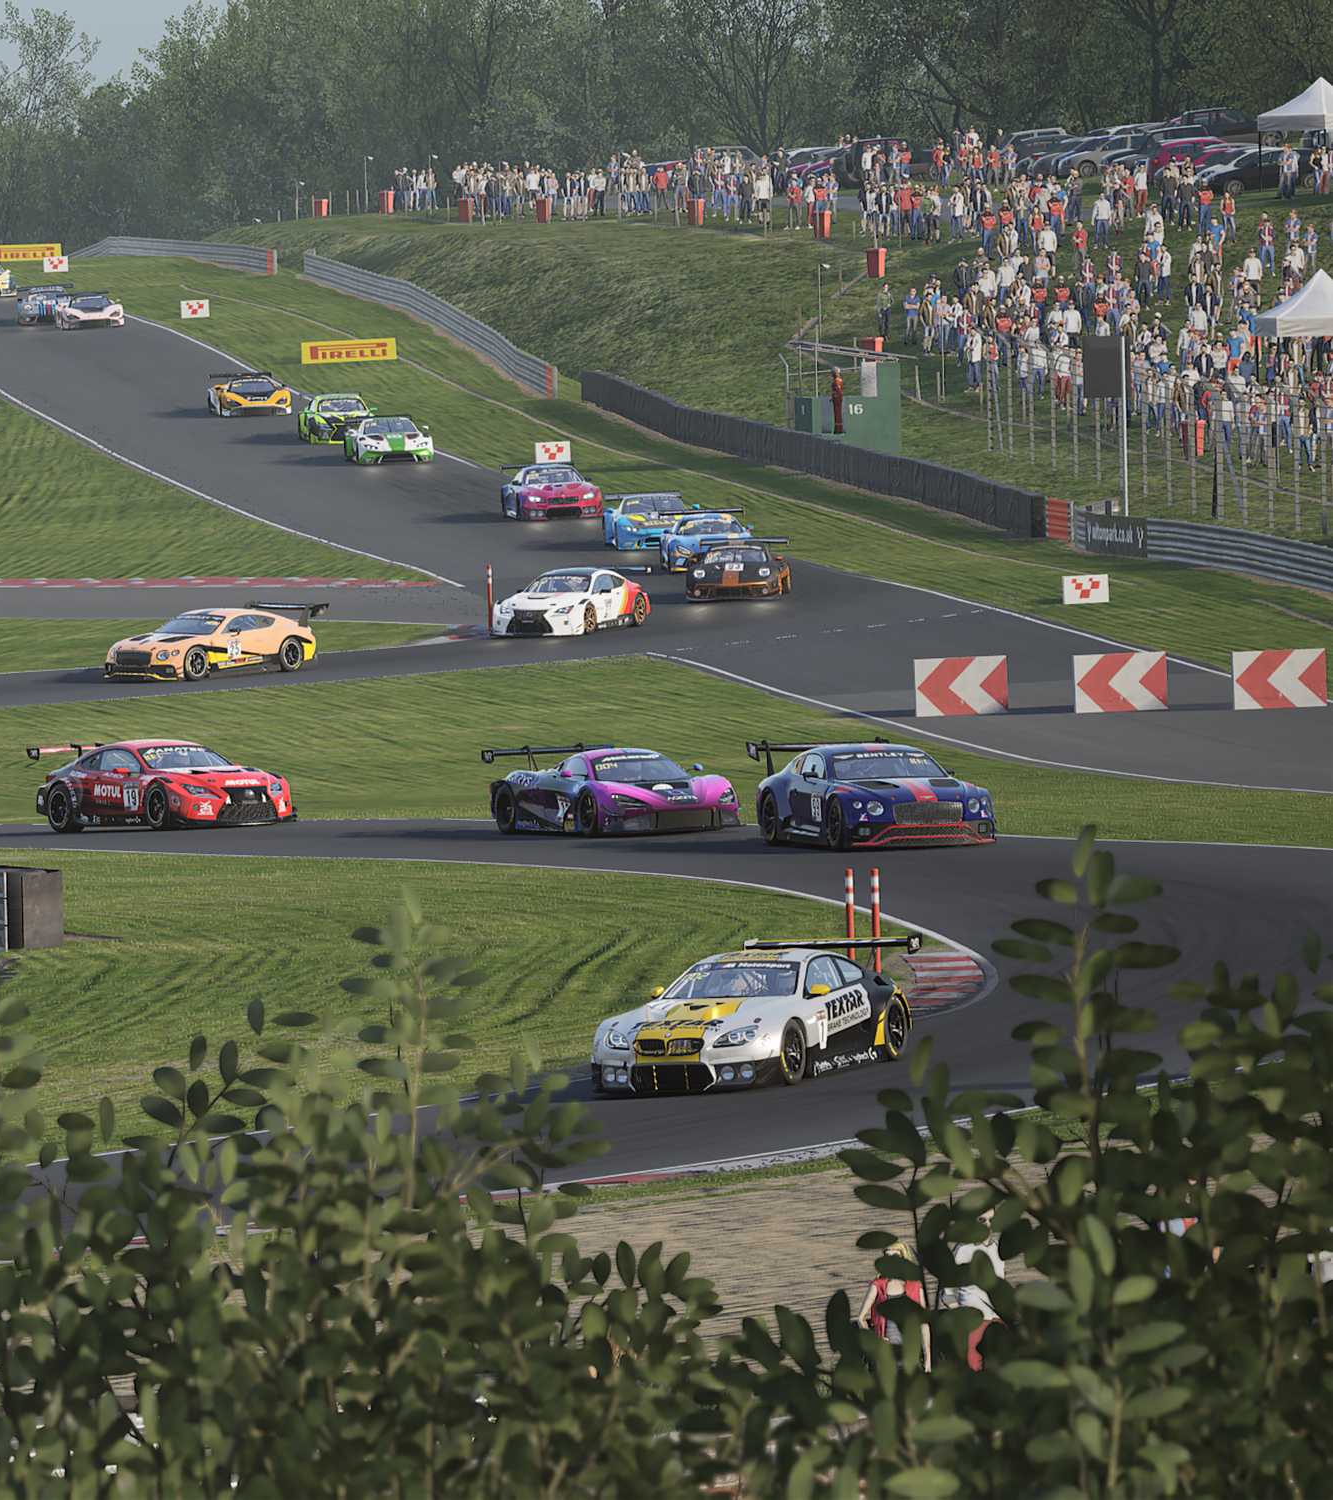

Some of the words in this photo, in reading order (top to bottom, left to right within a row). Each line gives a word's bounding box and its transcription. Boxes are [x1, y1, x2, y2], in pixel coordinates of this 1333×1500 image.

[309, 342, 388, 360] PIRELLI
[848, 404, 864, 415] 16
[224, 778, 260, 786] MOTUL
[94, 784, 122, 798] MOTUL
[127, 789, 137, 807] 19
[738, 962, 791, 970] Motorsport
[825, 988, 865, 1021] TEXTAR
